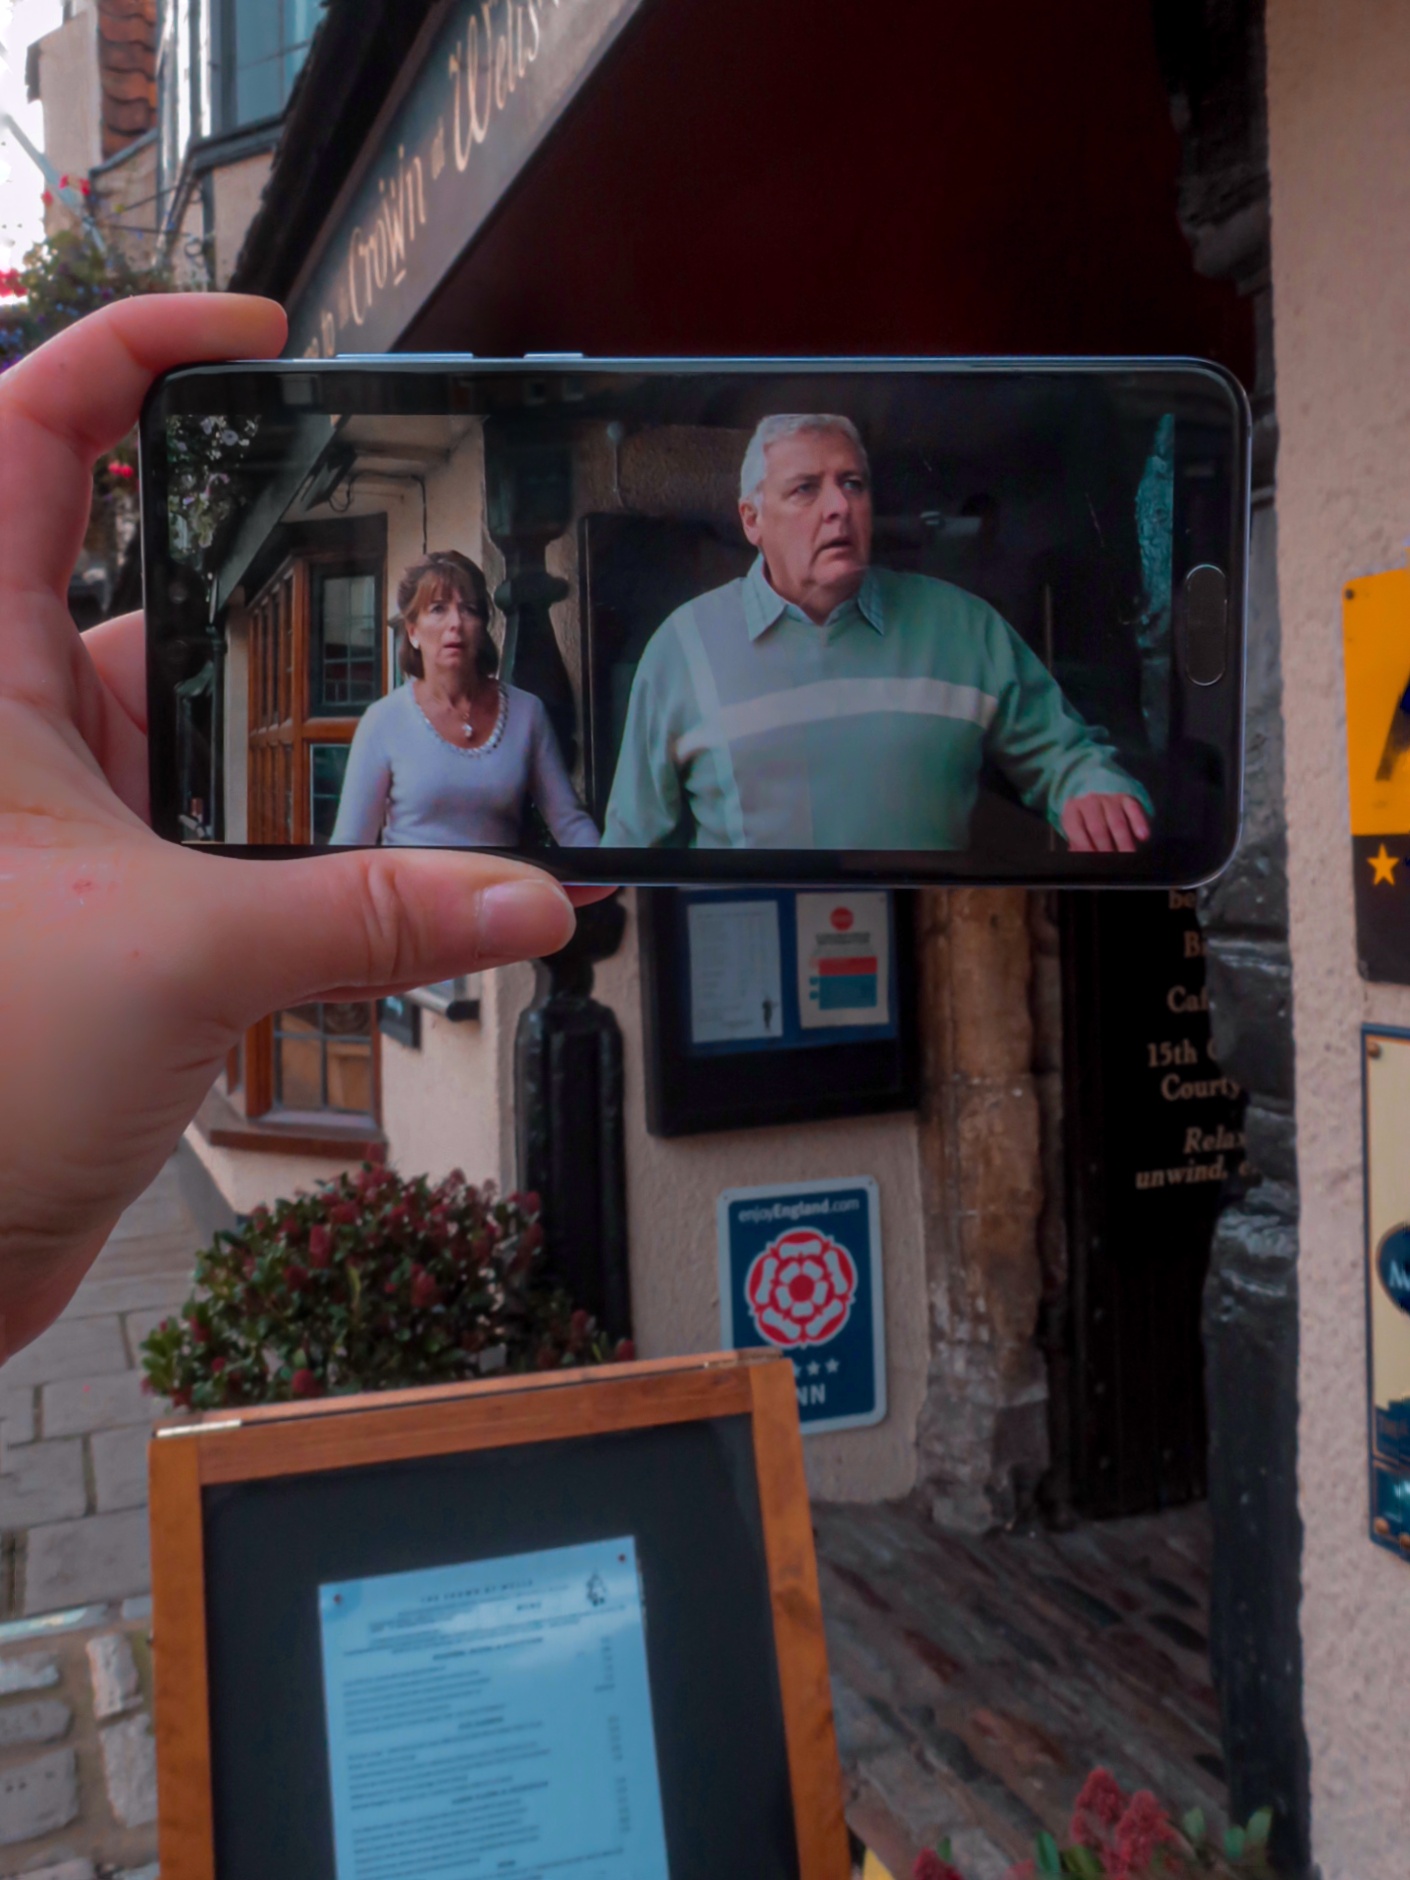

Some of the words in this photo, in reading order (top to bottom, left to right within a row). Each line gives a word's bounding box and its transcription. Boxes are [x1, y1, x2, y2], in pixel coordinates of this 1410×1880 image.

[1146, 1038, 1199, 1068] 15th
[1160, 1072, 1242, 1102] Courty
[796, 1383, 826, 1406] NN
